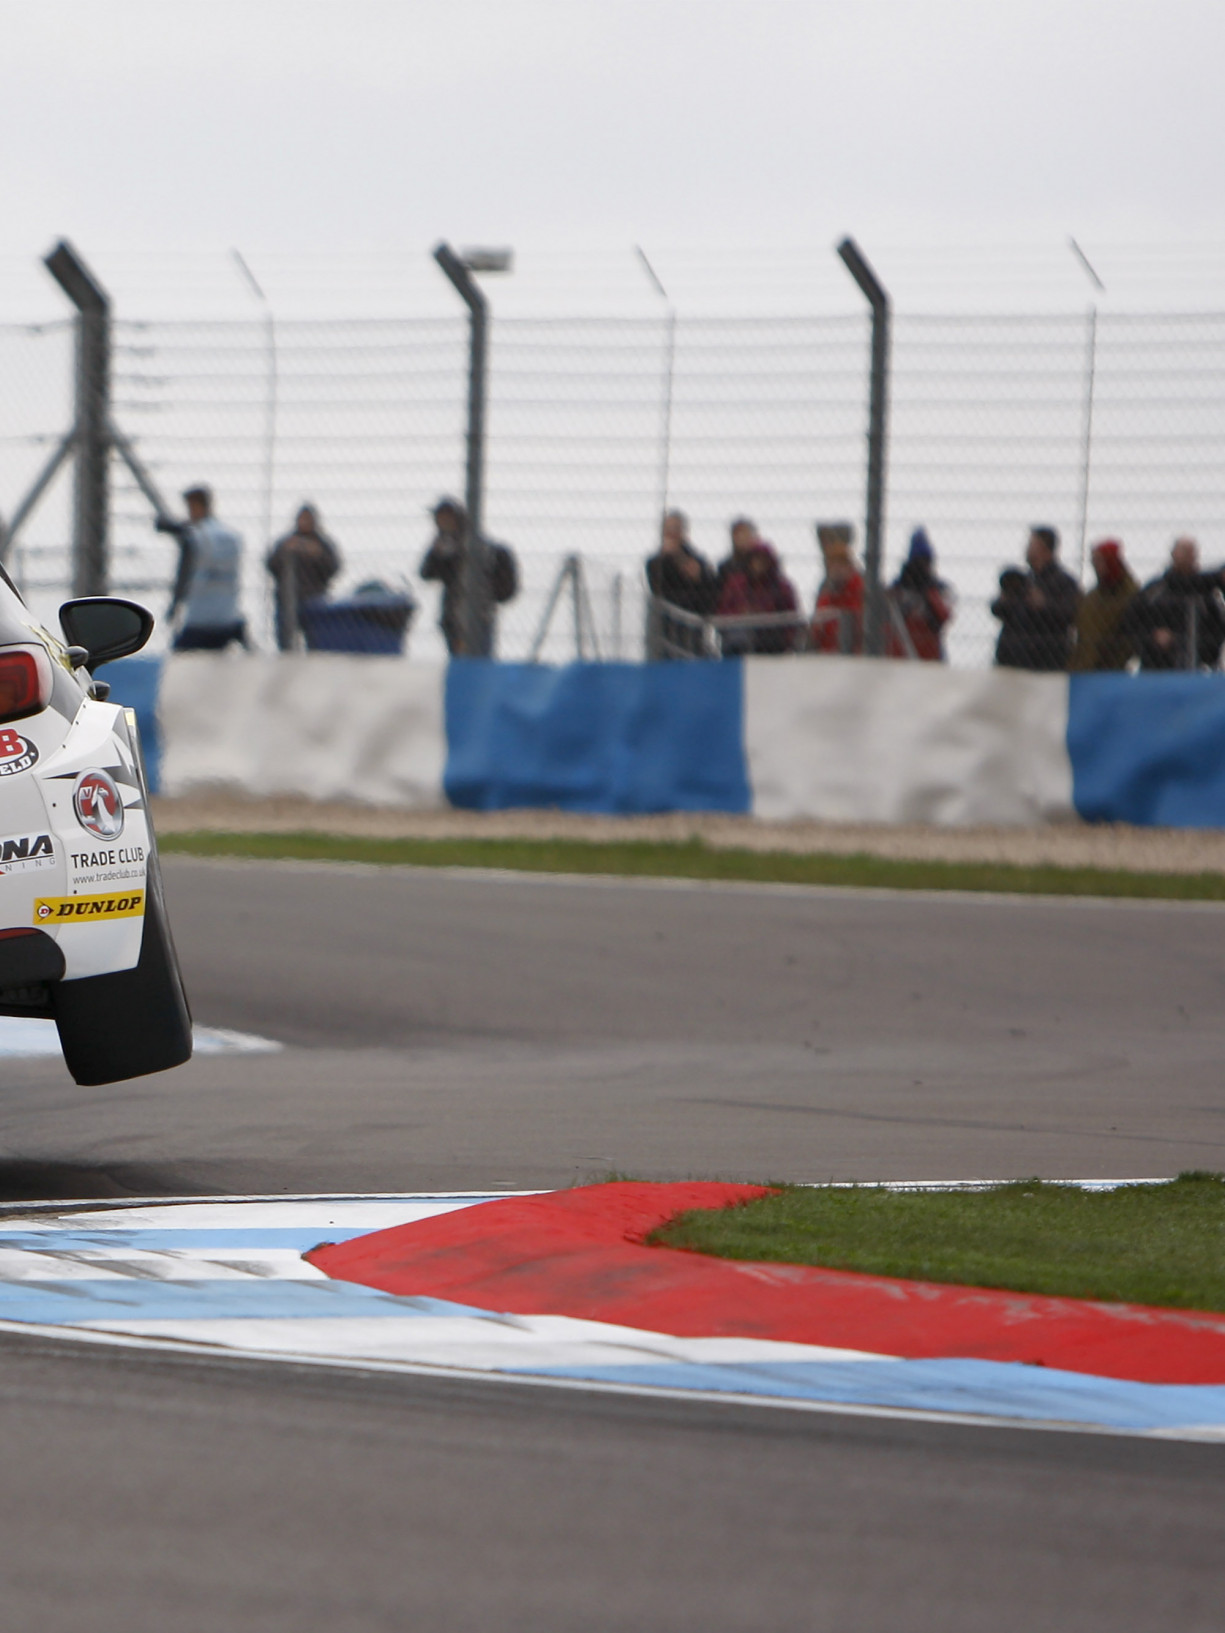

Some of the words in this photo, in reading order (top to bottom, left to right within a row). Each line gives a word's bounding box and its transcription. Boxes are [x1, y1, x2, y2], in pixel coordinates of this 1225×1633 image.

[70, 850, 116, 869] TRADE
[118, 847, 145, 864] CLUB
[55, 896, 142, 917] DUNLOP
